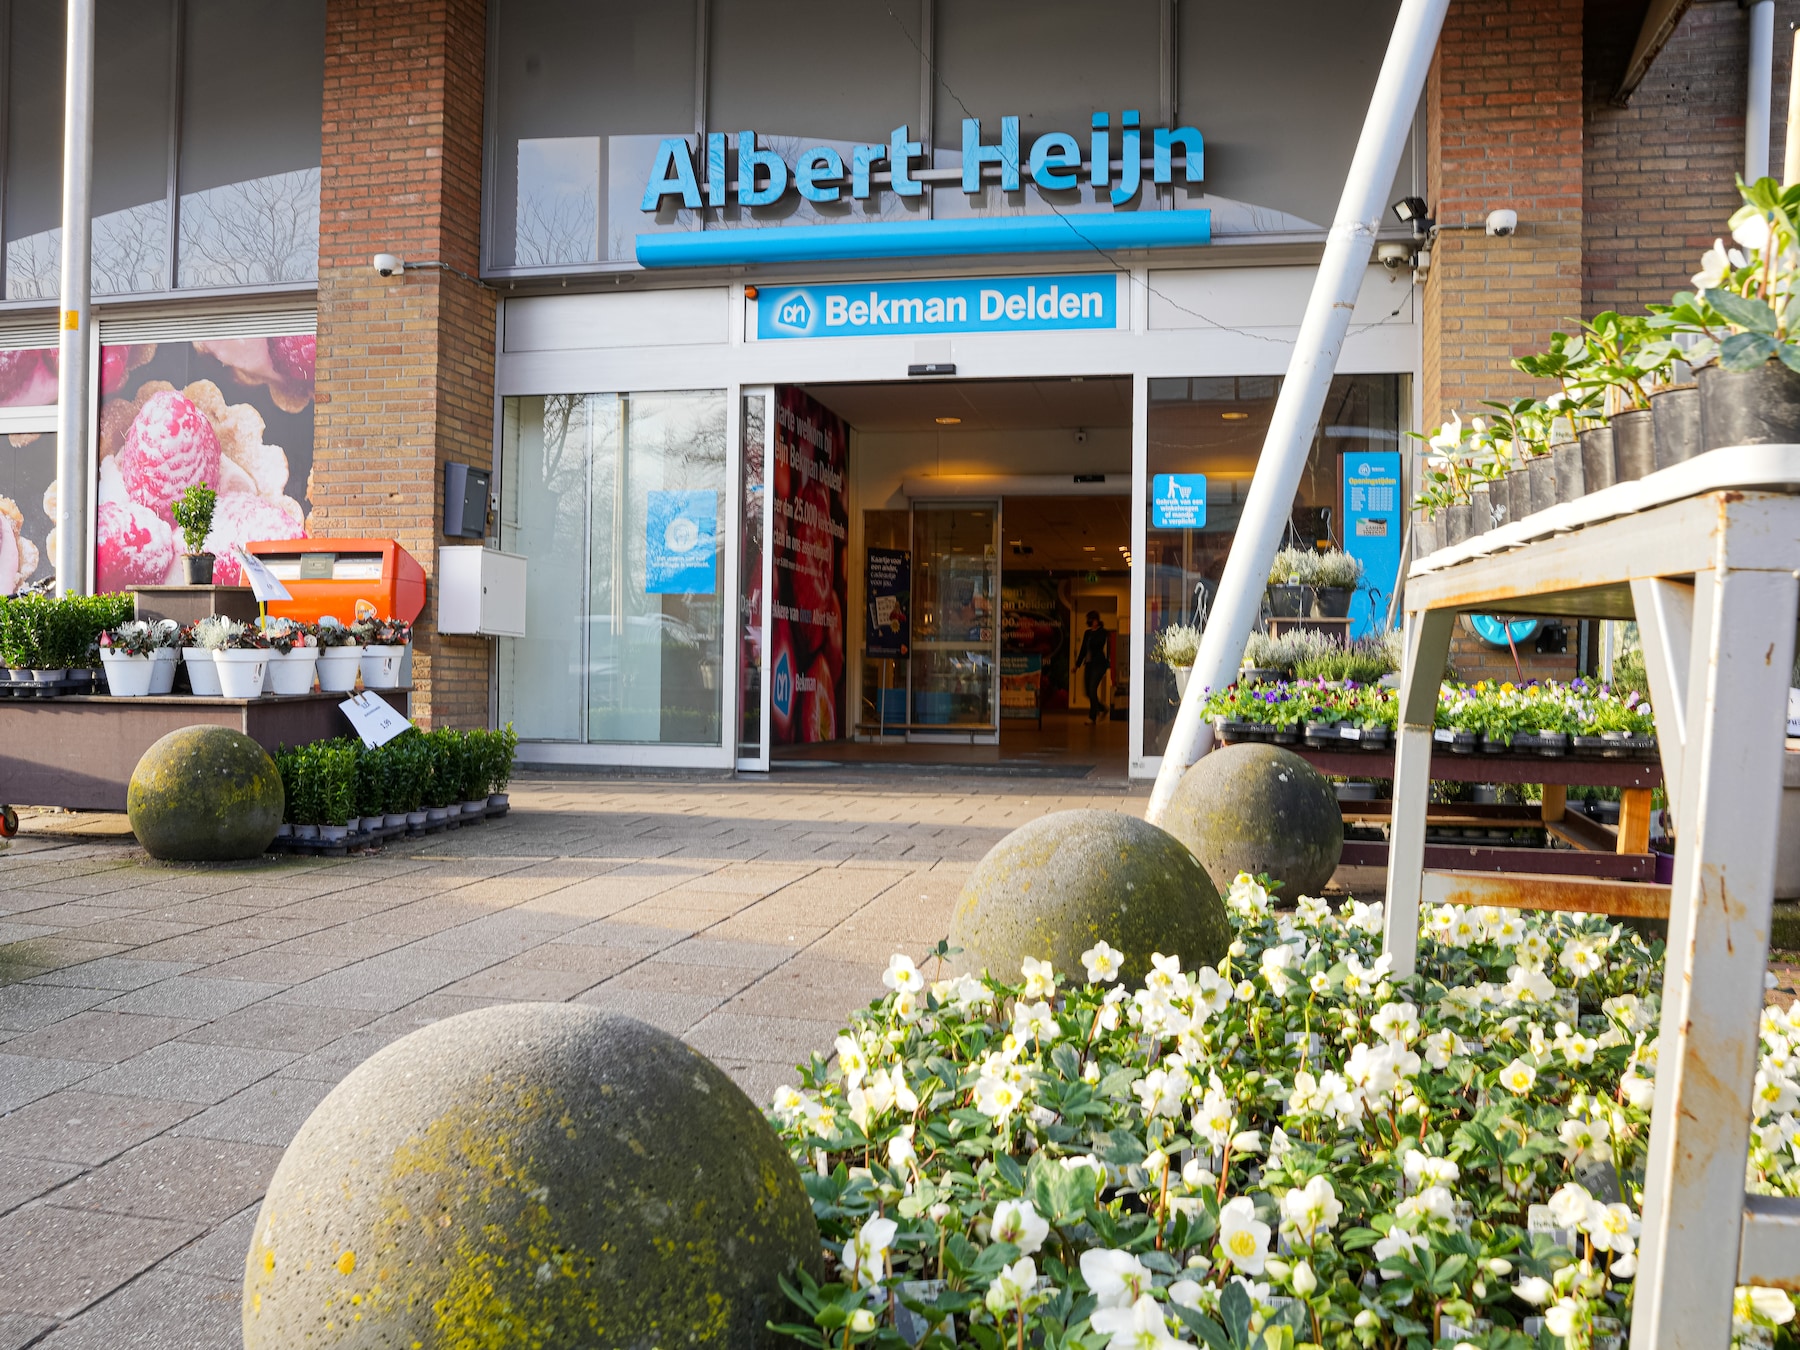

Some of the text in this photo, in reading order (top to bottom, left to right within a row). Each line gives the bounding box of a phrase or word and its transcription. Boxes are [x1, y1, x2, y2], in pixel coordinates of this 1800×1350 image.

[640, 109, 1205, 212] Albert Heijn
[825, 285, 1103, 327] Bekman Delden
[796, 415, 824, 451] welkom
[824, 427, 833, 461] bij
[775, 434, 842, 494] eijn Bekman Delden!
[1348, 476, 1397, 487] Openingstijden
[794, 495, 818, 529] 25.000
[1160, 505, 1199, 513] winkelwagen
[1169, 518, 1197, 526] verplicht!
[871, 555, 890, 565] Kaartje
[795, 672, 817, 692] Bekman
